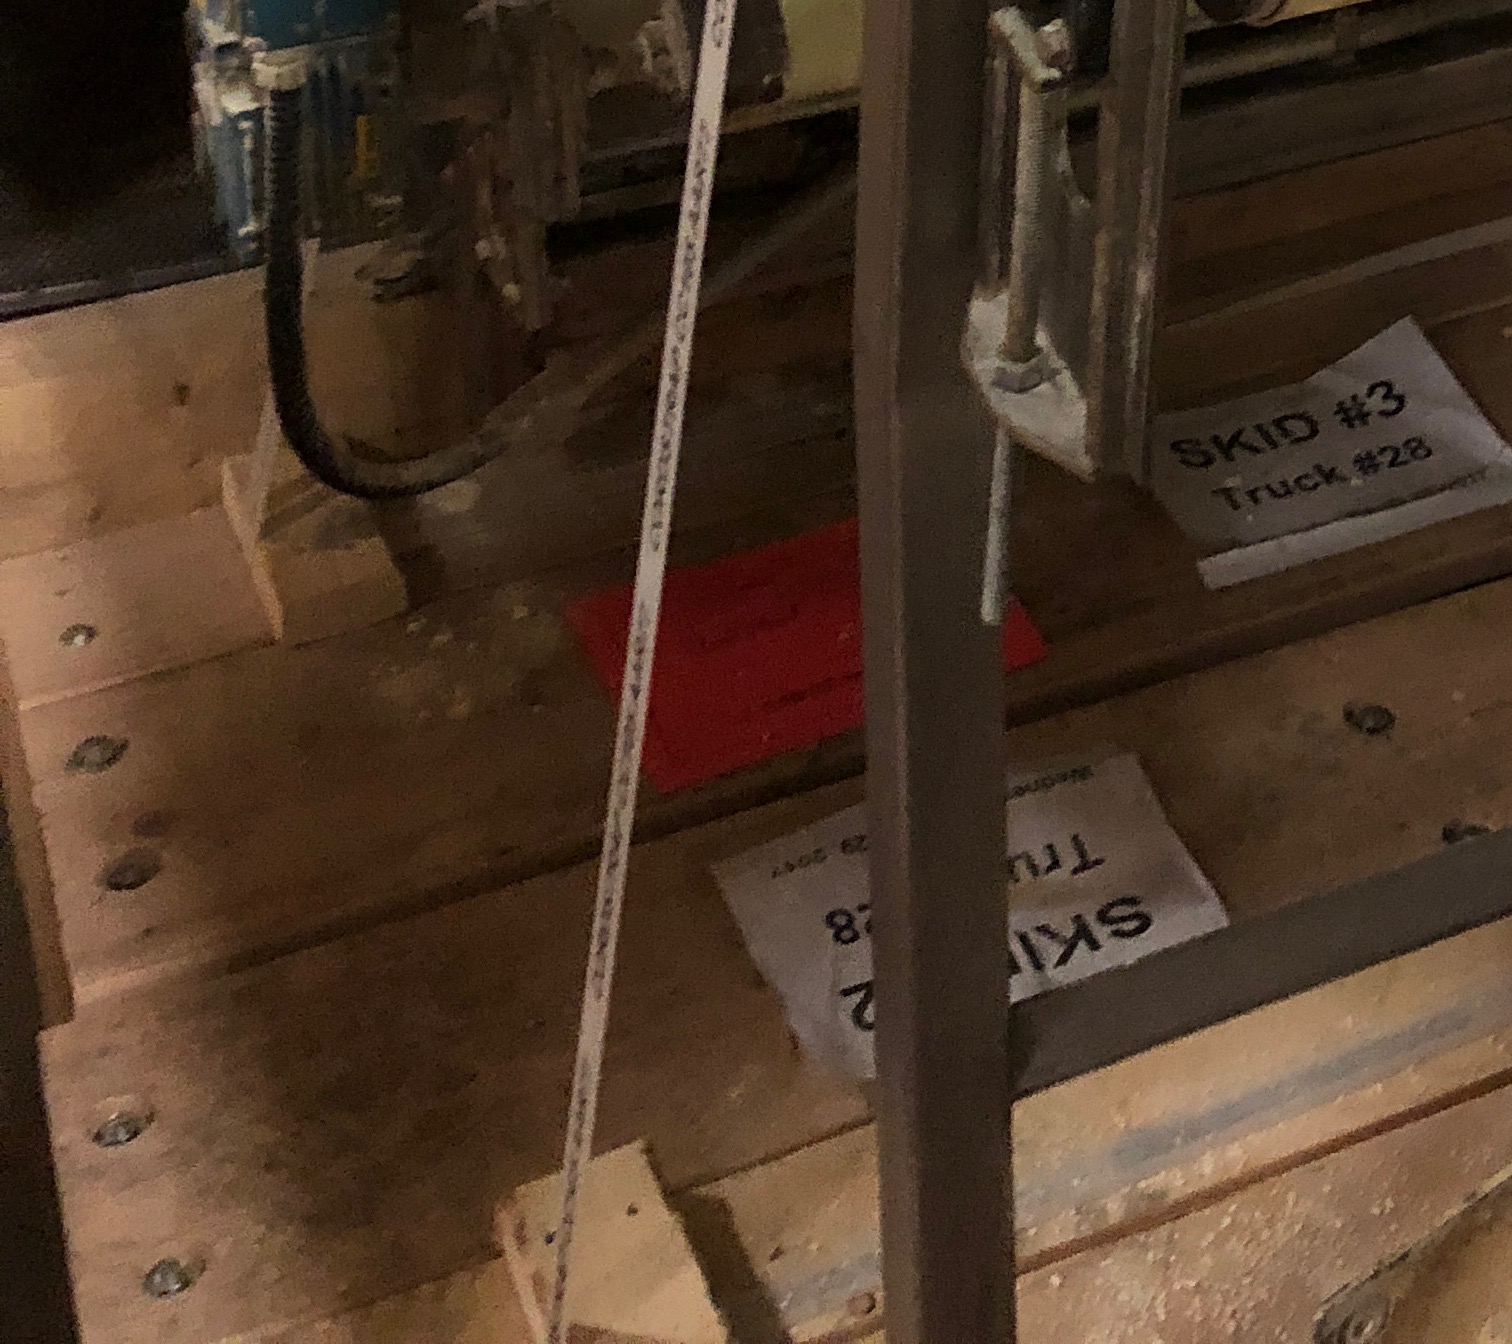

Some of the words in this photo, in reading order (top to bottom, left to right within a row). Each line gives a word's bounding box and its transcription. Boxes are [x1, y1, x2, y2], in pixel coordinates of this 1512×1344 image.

[1169, 410, 1321, 472] SKID
[1333, 379, 1407, 429] #3
[1210, 462, 1348, 512] Truck
[1352, 435, 1433, 477] #28
[1007, 832, 1106, 883] Tru
[839, 979, 874, 1032] 2
